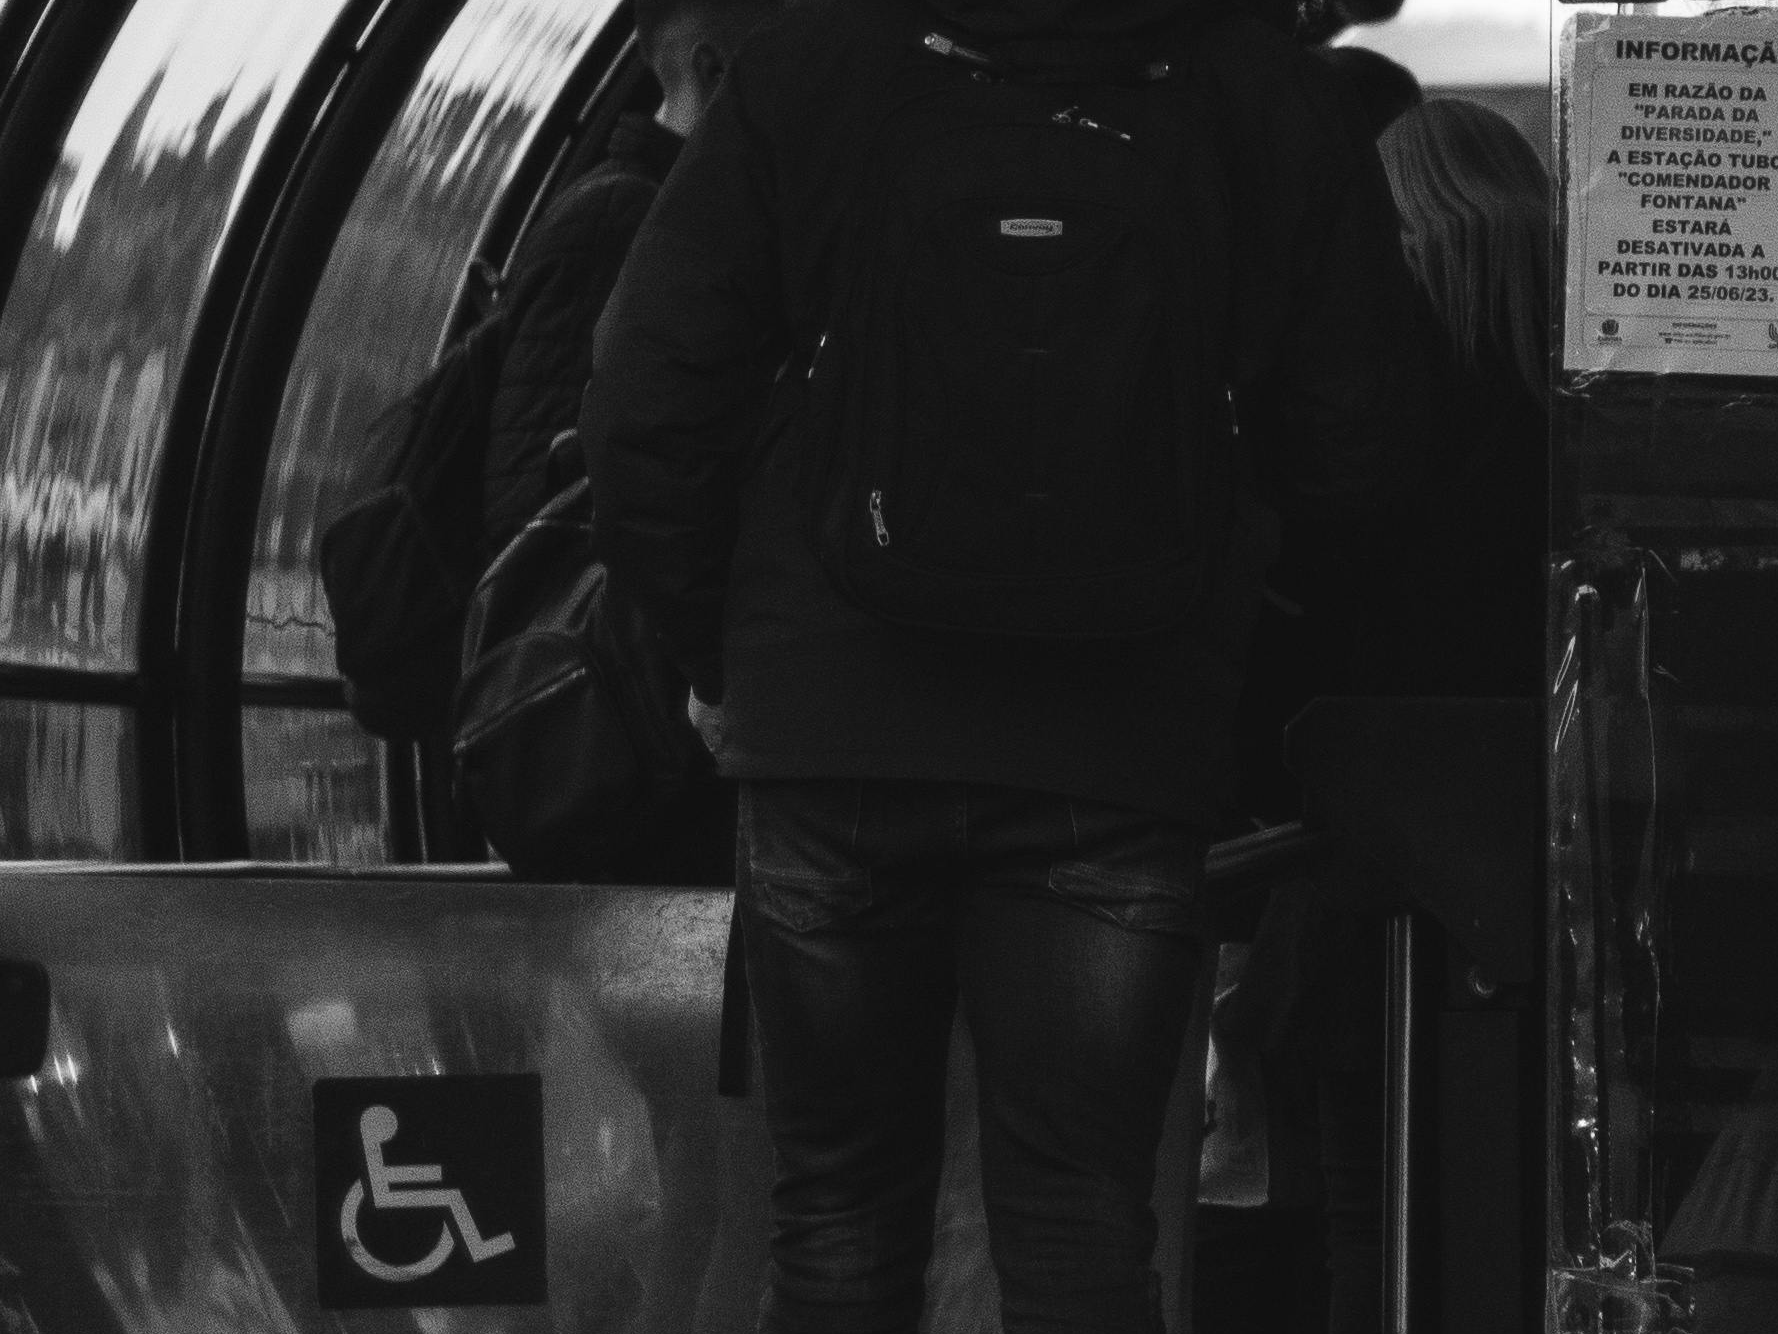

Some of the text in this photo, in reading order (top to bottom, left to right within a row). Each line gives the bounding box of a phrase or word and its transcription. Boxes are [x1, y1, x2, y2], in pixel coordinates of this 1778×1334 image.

[1628, 82, 1767, 101] EM RAZÃO DA
[1634, 103, 1759, 122] "PARADA DA
[1607, 150, 1621, 164] A
[1628, 150, 1722, 169] ESTAÇÃO
[1618, 172, 1770, 190] "COMENDADOR
[1641, 194, 1746, 211] FONTANA"
[1652, 218, 1732, 235] ESTARÁ
[1617, 239, 1765, 258] DESATIVADA A
[1598, 260, 1671, 277] PARTIR
[1678, 263, 1718, 279] DAS
[1613, 282, 1774, 302] DO DIA 25/06/23.
